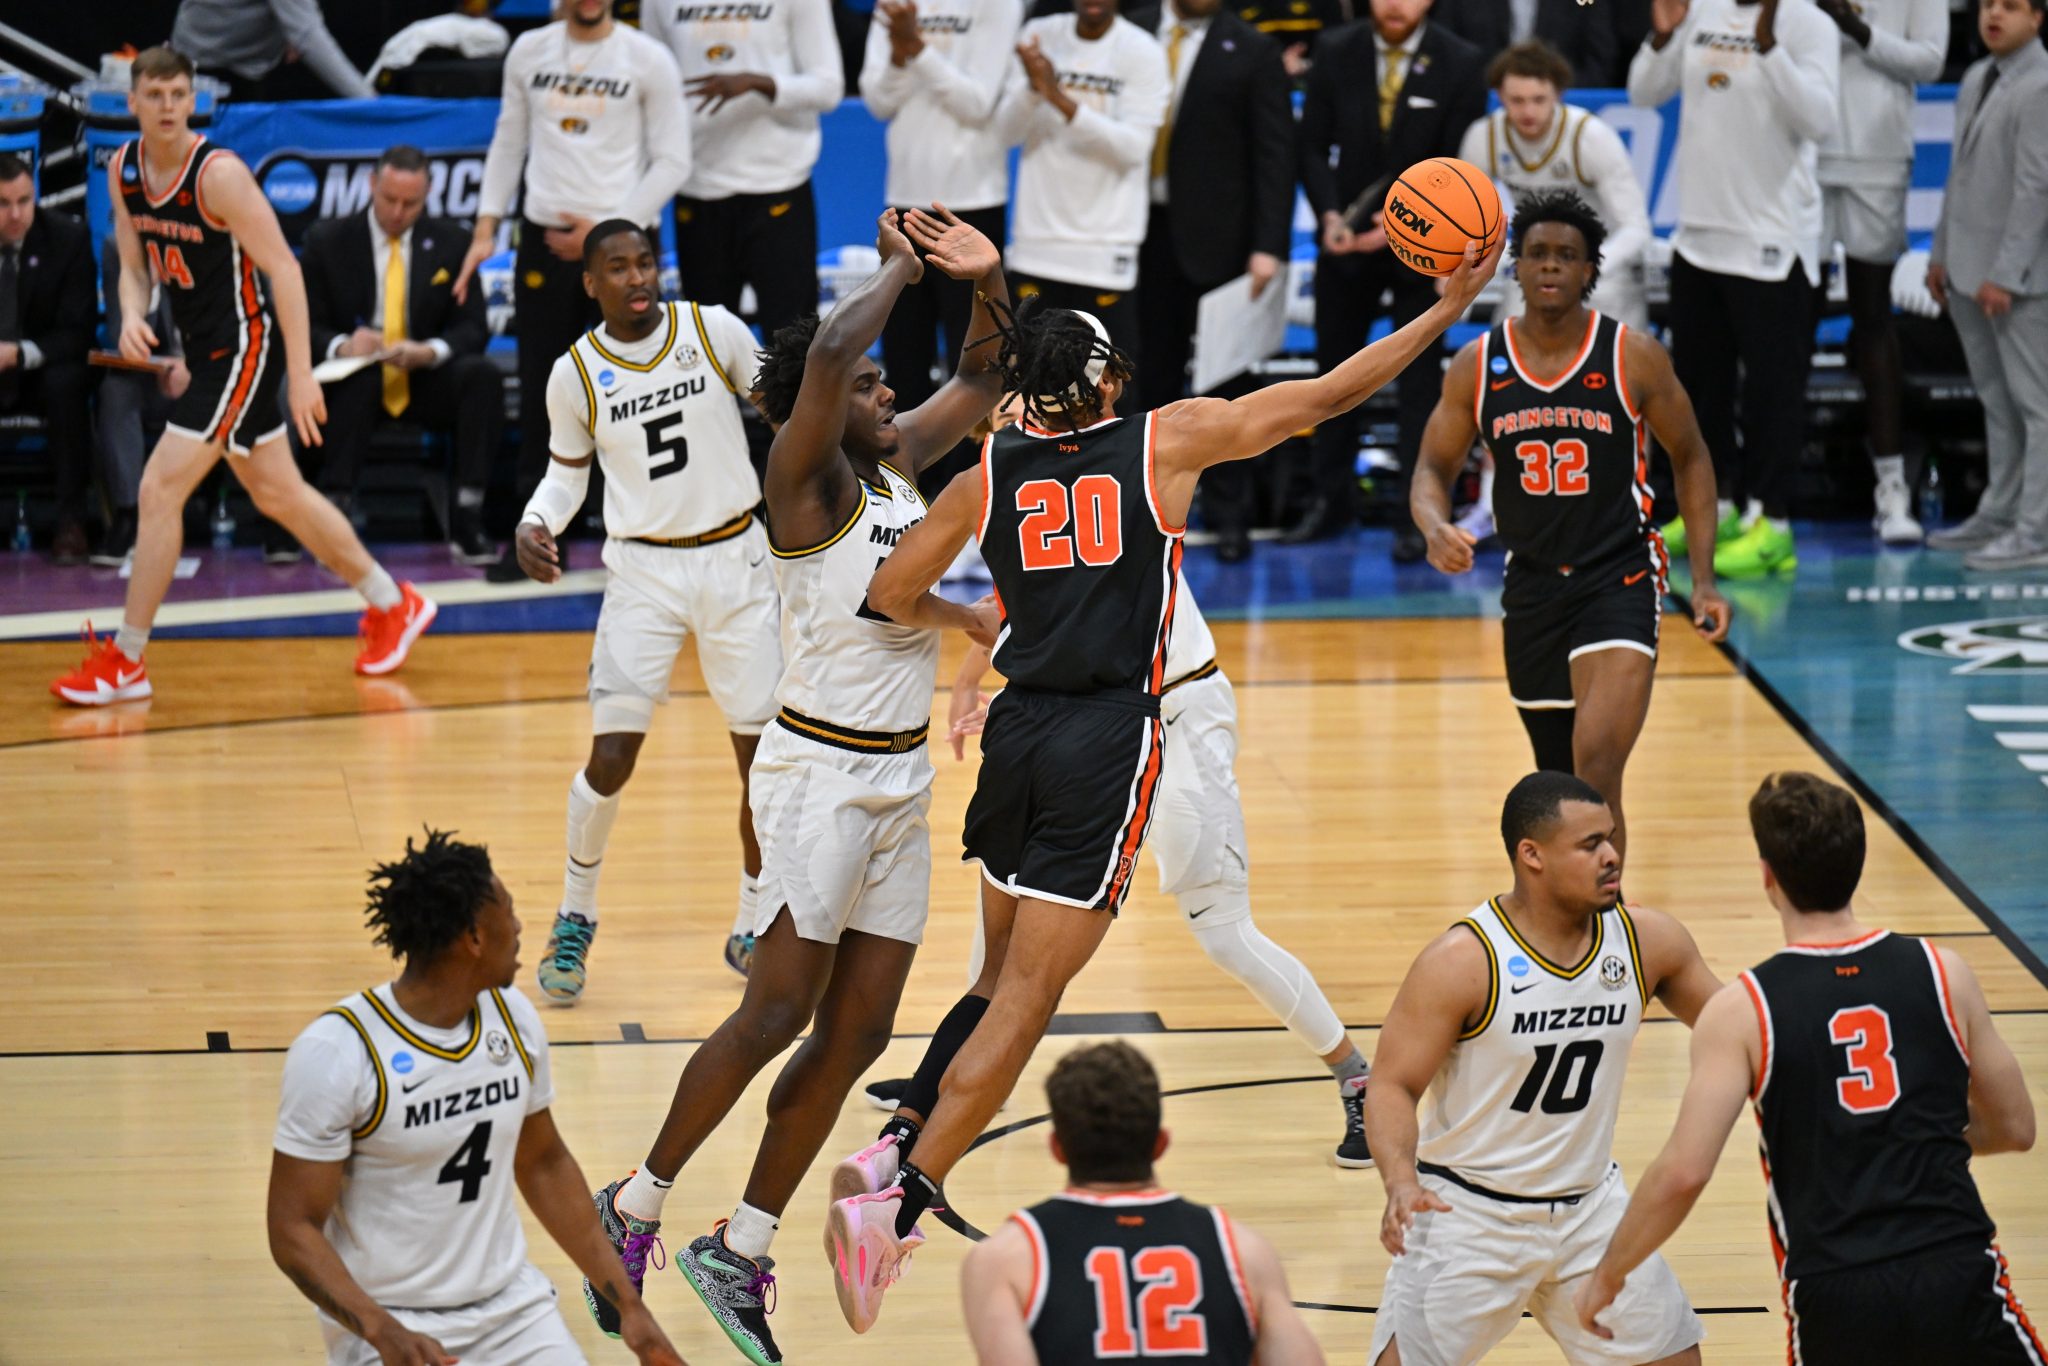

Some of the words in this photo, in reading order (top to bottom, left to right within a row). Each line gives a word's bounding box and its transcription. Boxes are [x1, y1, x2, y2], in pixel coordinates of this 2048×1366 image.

[676, 4, 774, 23] MIZZOU
[531, 72, 631, 98] MIZZOU
[1389, 196, 1434, 238] NCAA
[145, 240, 195, 289] 14
[610, 375, 705, 423] MIZZOU
[1493, 406, 1613, 440] PRINCETON
[641, 410, 688, 481] 5
[1515, 438, 1589, 496] 32
[1015, 474, 1123, 571] 20
[1511, 1003, 1627, 1034] MIZZOU
[1509, 1039, 1605, 1115] 10
[1827, 1003, 1901, 1115] 3
[404, 1075, 519, 1129] MIZZOU
[436, 1119, 493, 1204] 4
[1084, 1244, 1208, 1359] 12
